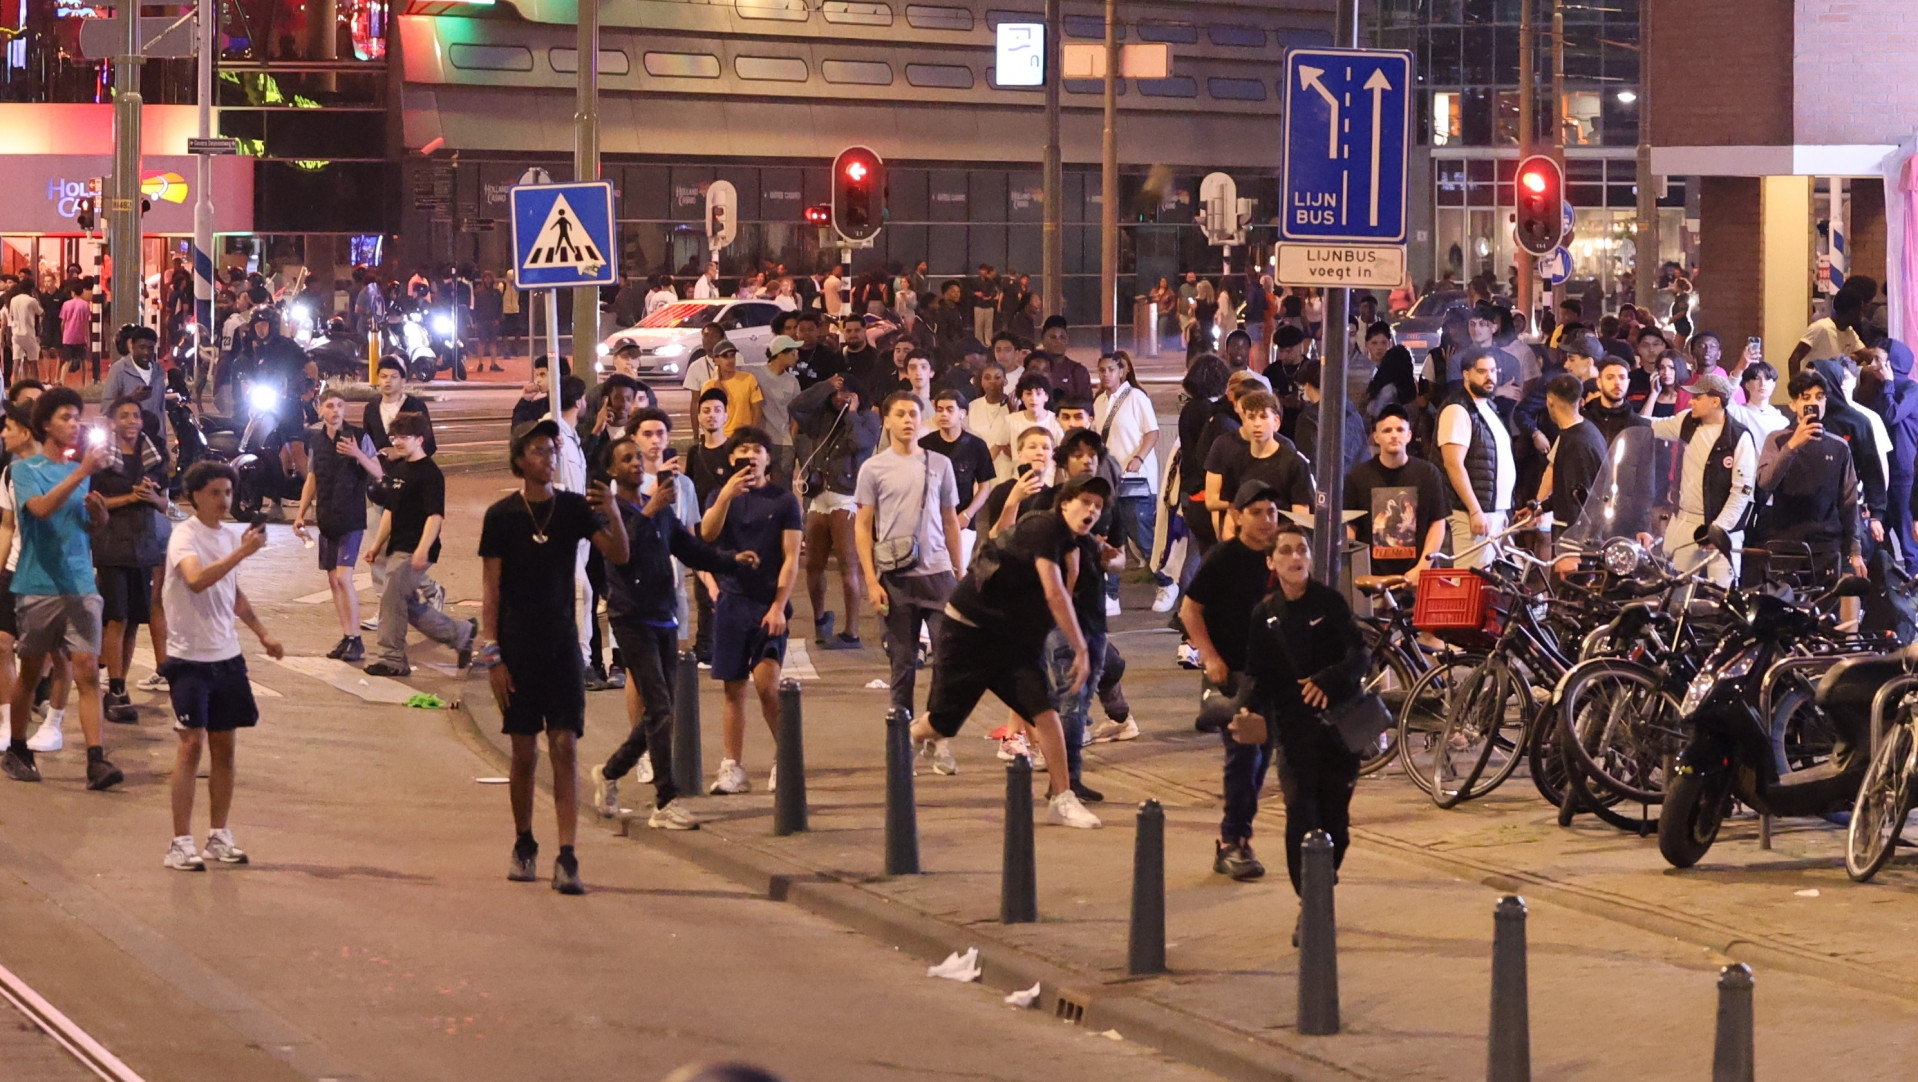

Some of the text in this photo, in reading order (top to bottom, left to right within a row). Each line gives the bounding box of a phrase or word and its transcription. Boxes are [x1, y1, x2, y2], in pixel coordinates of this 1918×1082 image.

[1294, 191, 1337, 208] LIJN
[1296, 209, 1335, 225] BUS
[1307, 249, 1377, 263] LIJNBUS
[1309, 266, 1372, 281] voegt in
